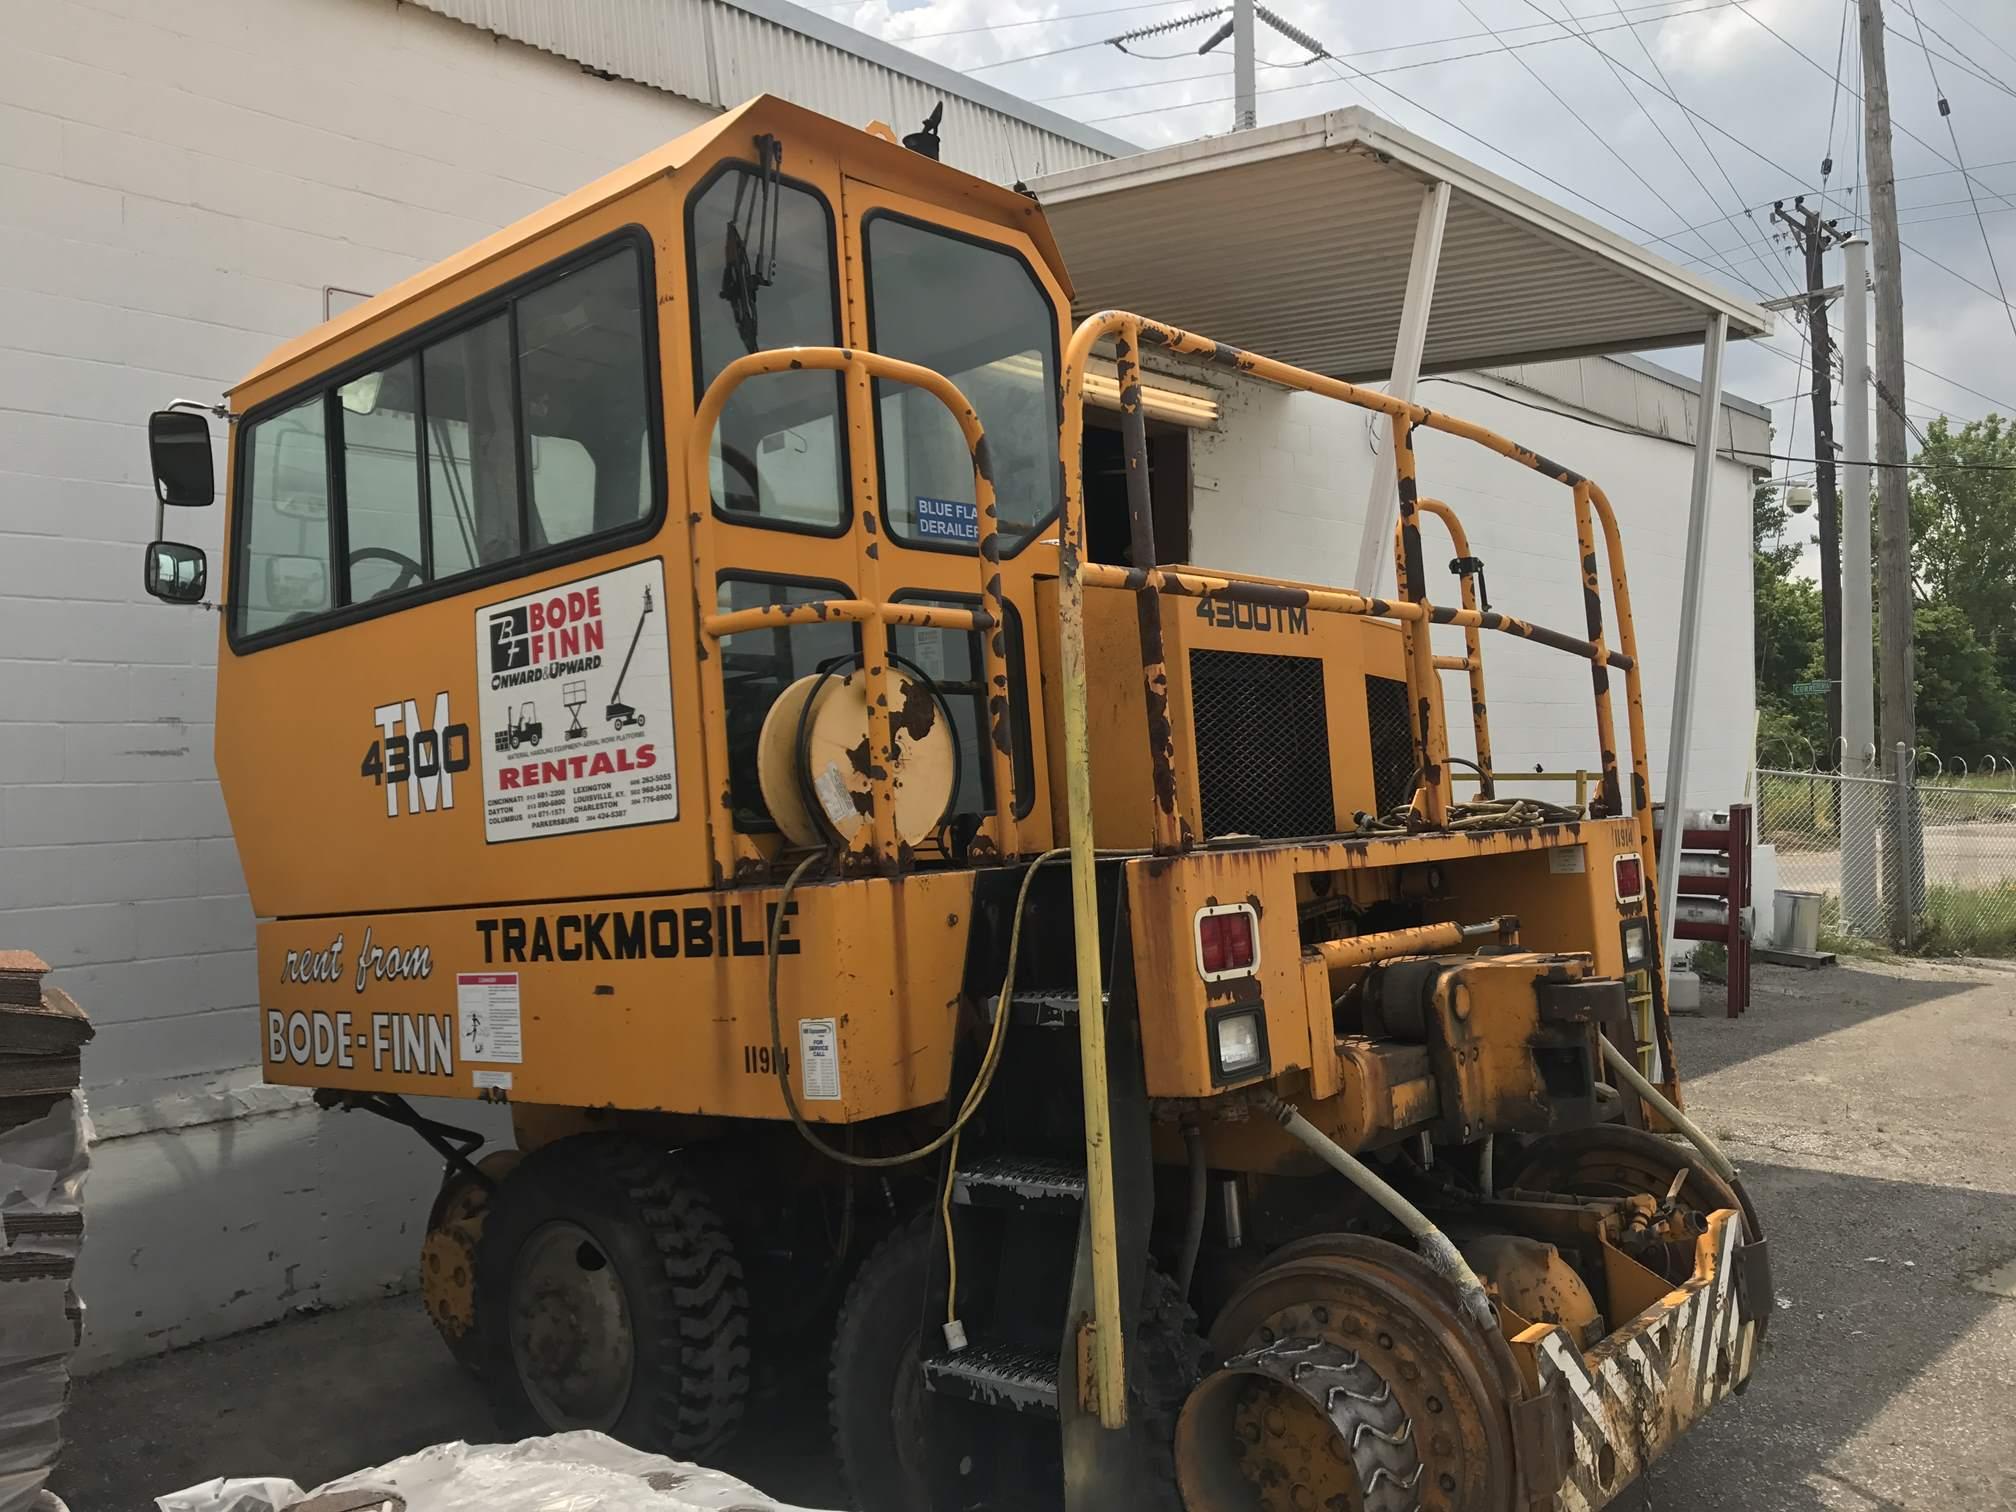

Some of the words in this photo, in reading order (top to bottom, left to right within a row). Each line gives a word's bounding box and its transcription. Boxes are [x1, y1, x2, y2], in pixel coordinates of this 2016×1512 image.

[919, 500, 953, 517] BLUE
[956, 505, 977, 520] FLA
[529, 586, 602, 632] BODE
[1196, 597, 1308, 635] 4300TM
[531, 620, 604, 665] FINN
[361, 723, 470, 786] 4300
[374, 691, 454, 817] TM
[499, 744, 656, 790] RENTALS
[488, 796, 524, 806] CINCINNATI
[573, 782, 612, 794] LEXINGTON
[573, 801, 618, 813] CHARLESTON
[488, 807, 513, 815] DAYTON
[489, 815, 523, 824] COLUMBUS
[531, 816, 579, 829] PARKERSBURG
[1614, 827, 1633, 848] 11914
[476, 901, 800, 963] TRACKMOBILE
[281, 932, 344, 984] rent
[355, 926, 433, 994] from
[267, 1008, 454, 1077] BODE-FINN
